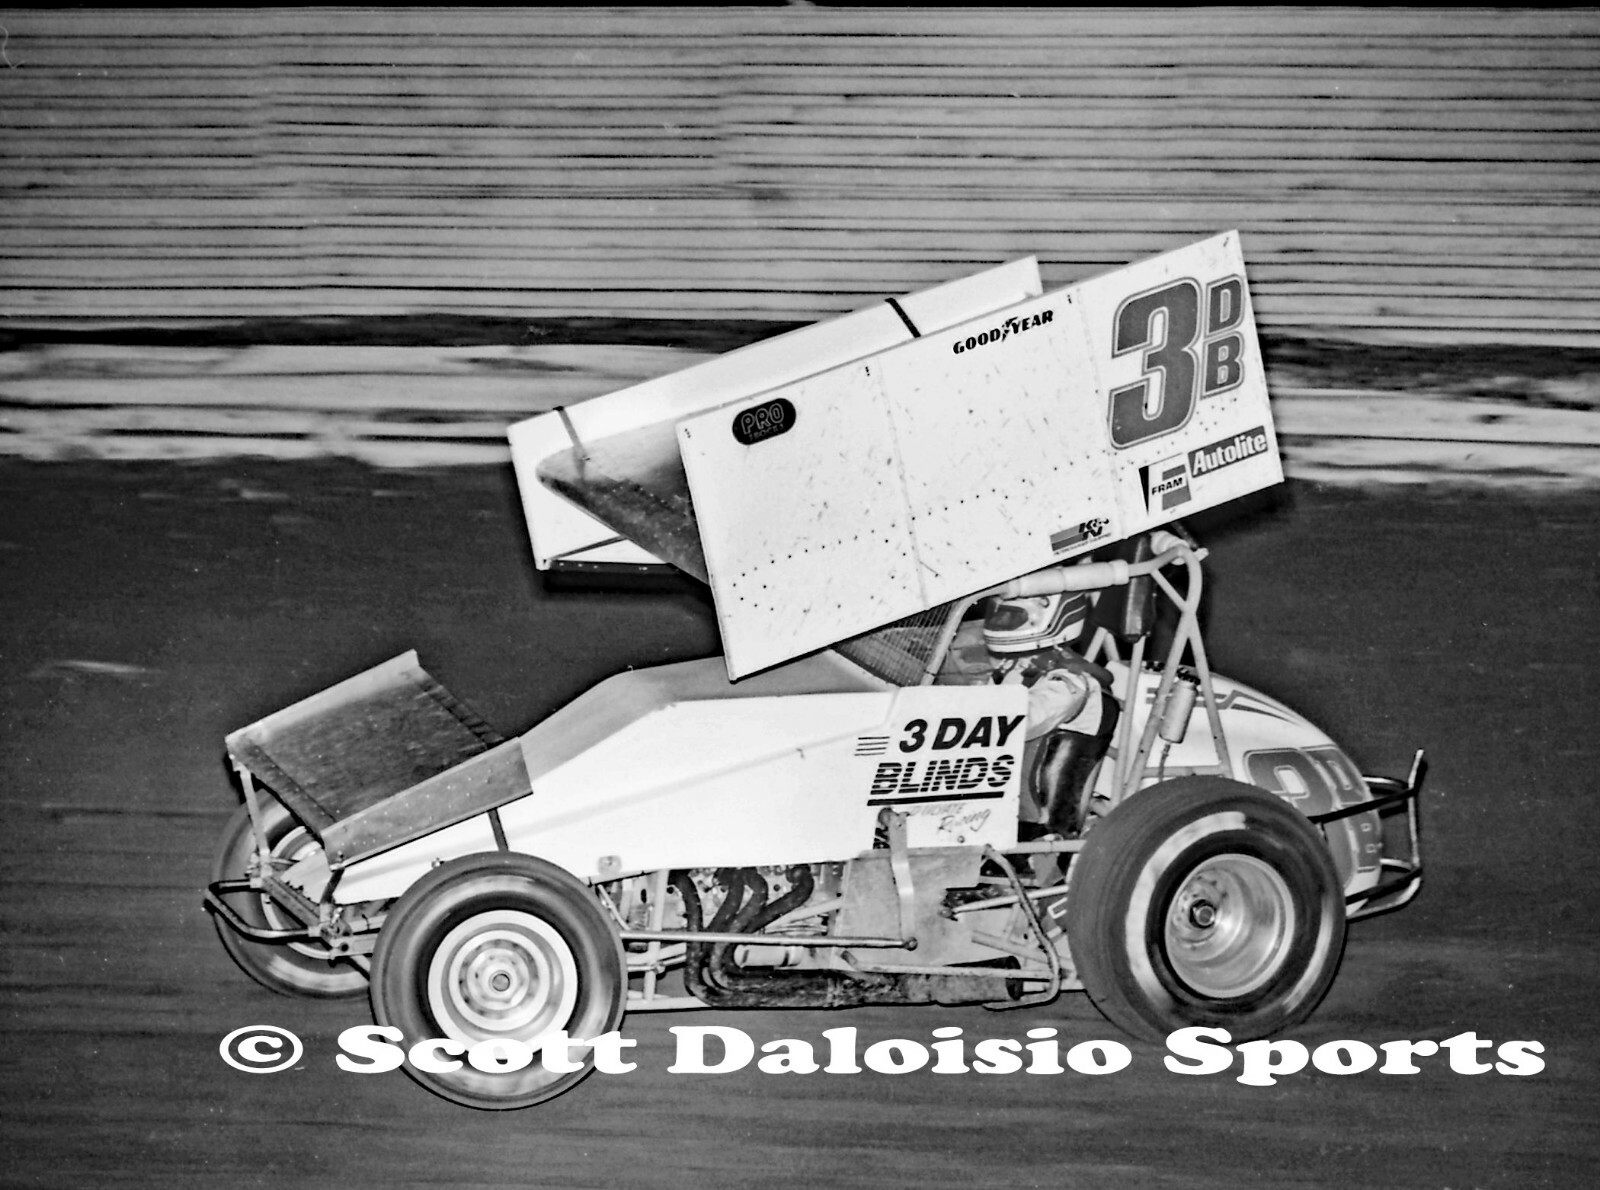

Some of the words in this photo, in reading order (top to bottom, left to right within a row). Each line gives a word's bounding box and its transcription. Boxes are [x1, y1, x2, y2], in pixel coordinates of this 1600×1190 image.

[952, 309, 1054, 354] GOODYEAR
[1107, 276, 1202, 450] 3
[741, 403, 785, 435] PRO
[1191, 433, 1267, 476] Autolite
[1151, 477, 1183, 496] FRAM
[899, 718, 929, 753] 3
[931, 714, 1026, 751] DAY
[870, 754, 1015, 796] BLINDS
